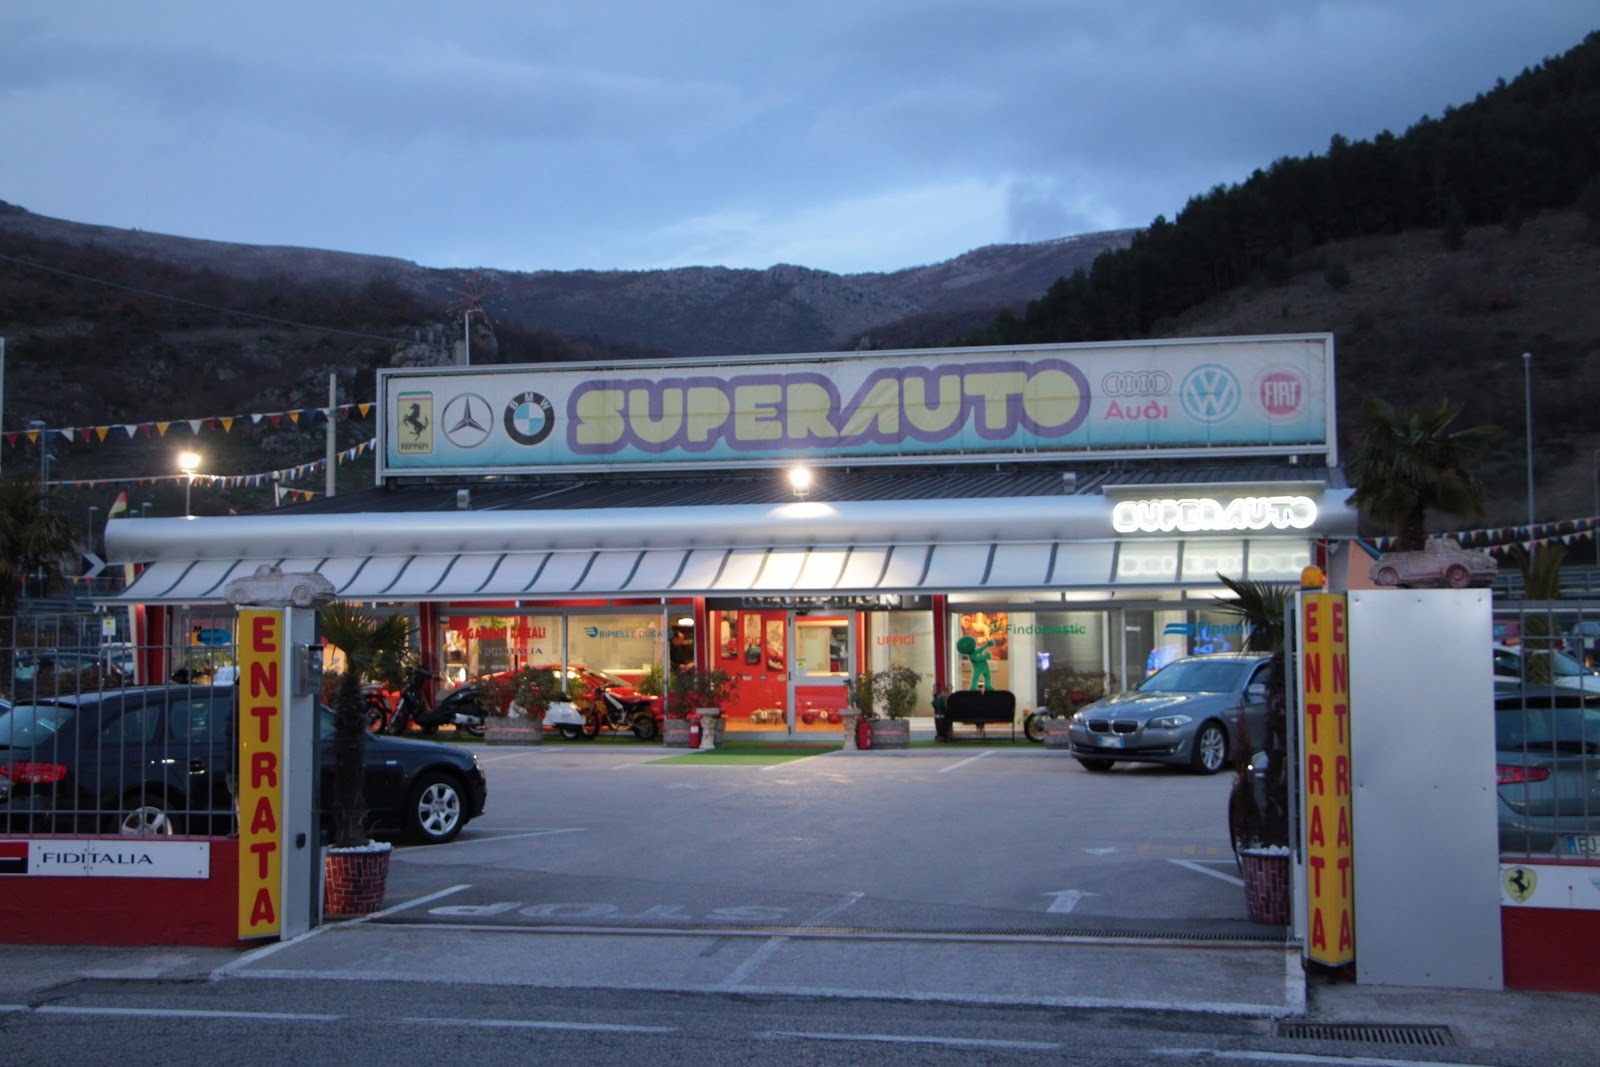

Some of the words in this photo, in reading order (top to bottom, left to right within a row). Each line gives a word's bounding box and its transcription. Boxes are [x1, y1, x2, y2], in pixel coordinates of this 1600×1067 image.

[509, 391, 551, 411] BMW
[1264, 381, 1298, 407] FIAT
[569, 361, 1088, 453] SUPERAUTO
[1103, 399, 1169, 421] Audi
[1112, 496, 1318, 533] SUPERAUTO
[638, 628, 676, 639] DUCAO
[876, 635, 916, 646] UFFICI
[1005, 623, 1087, 635] Findomestic
[249, 616, 278, 927] ENTRATA
[1304, 602, 1327, 952] ENTRATA
[1332, 602, 1352, 952] ENTRATA
[41, 851, 154, 865] FIDITALIA
